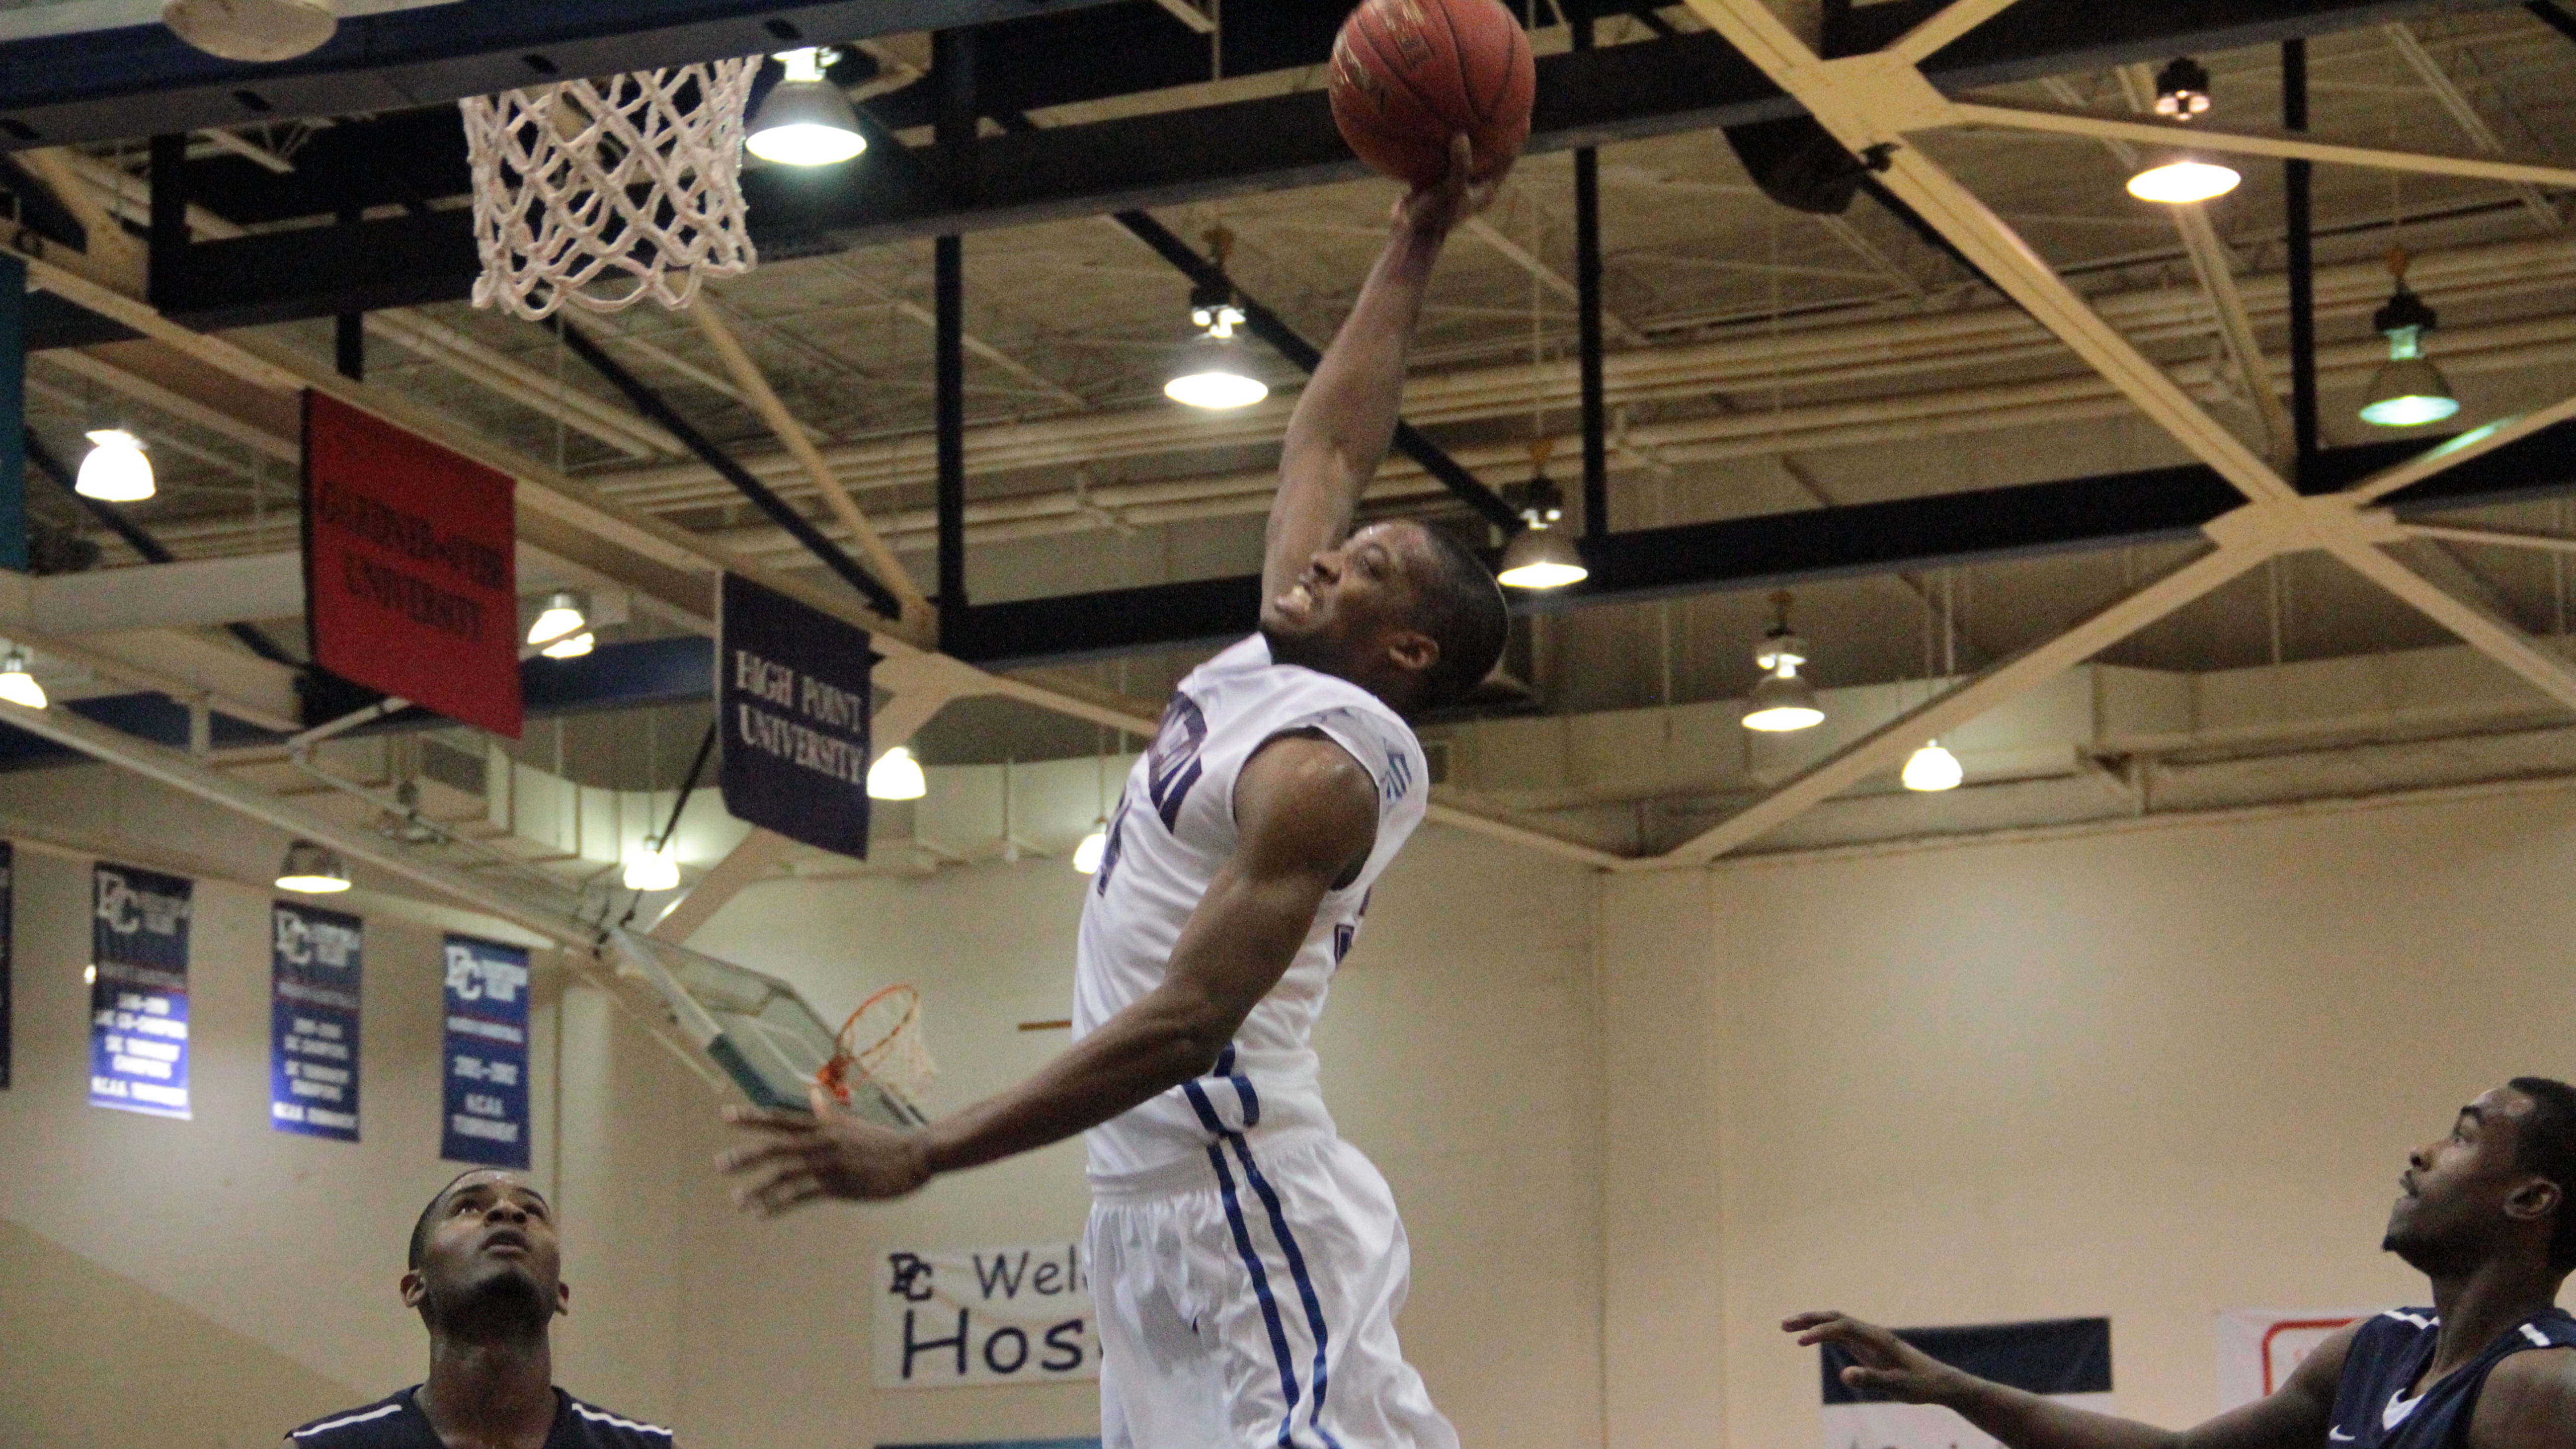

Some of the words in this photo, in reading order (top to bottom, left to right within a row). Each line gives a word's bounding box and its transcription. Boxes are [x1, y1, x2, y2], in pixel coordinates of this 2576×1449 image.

[736, 649, 794, 708] HIGH
[801, 675, 862, 733] POINT
[740, 703, 864, 786] UNIVERSITY
[972, 1244, 1088, 1299] Wel
[902, 1307, 1104, 1379] Hos
